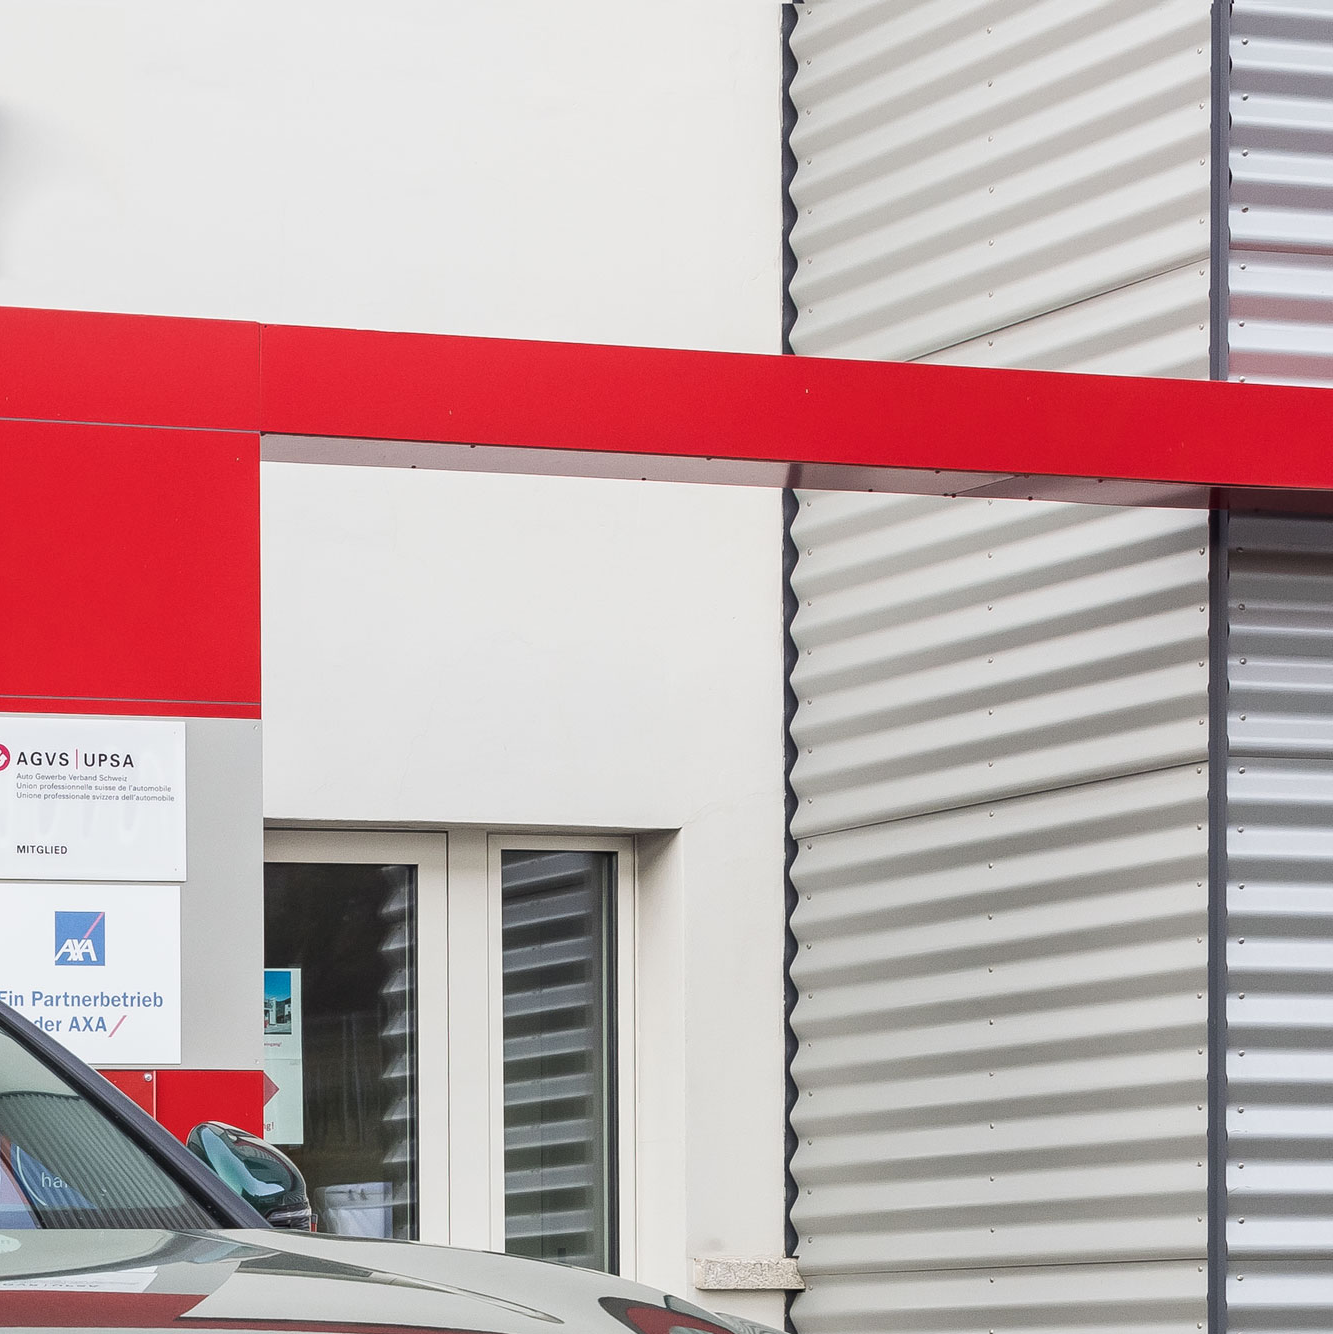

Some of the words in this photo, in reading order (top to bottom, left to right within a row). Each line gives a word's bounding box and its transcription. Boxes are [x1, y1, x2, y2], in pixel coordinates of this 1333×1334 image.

[16, 751, 69, 767] AGVS
[84, 753, 135, 768] UPSA
[35, 773, 67, 781] Gewerbe
[68, 774, 98, 782] Verband
[99, 774, 128, 783] Schweiz
[16, 782, 38, 790] Union
[39, 783, 93, 792] professionnelle
[94, 784, 116, 792] suisse
[118, 784, 127, 792] de
[128, 785, 172, 793] l'automobile
[16, 792, 42, 800] Unione
[43, 792, 91, 802] professionale
[92, 793, 120, 801] svizzera
[121, 794, 175, 802] dell'automobile
[16, 844, 68, 855] MITGLIED
[54, 938, 98, 962] AXA
[32, 991, 164, 1008] Partnerbetrieb
[34, 1016, 62, 1032] der
